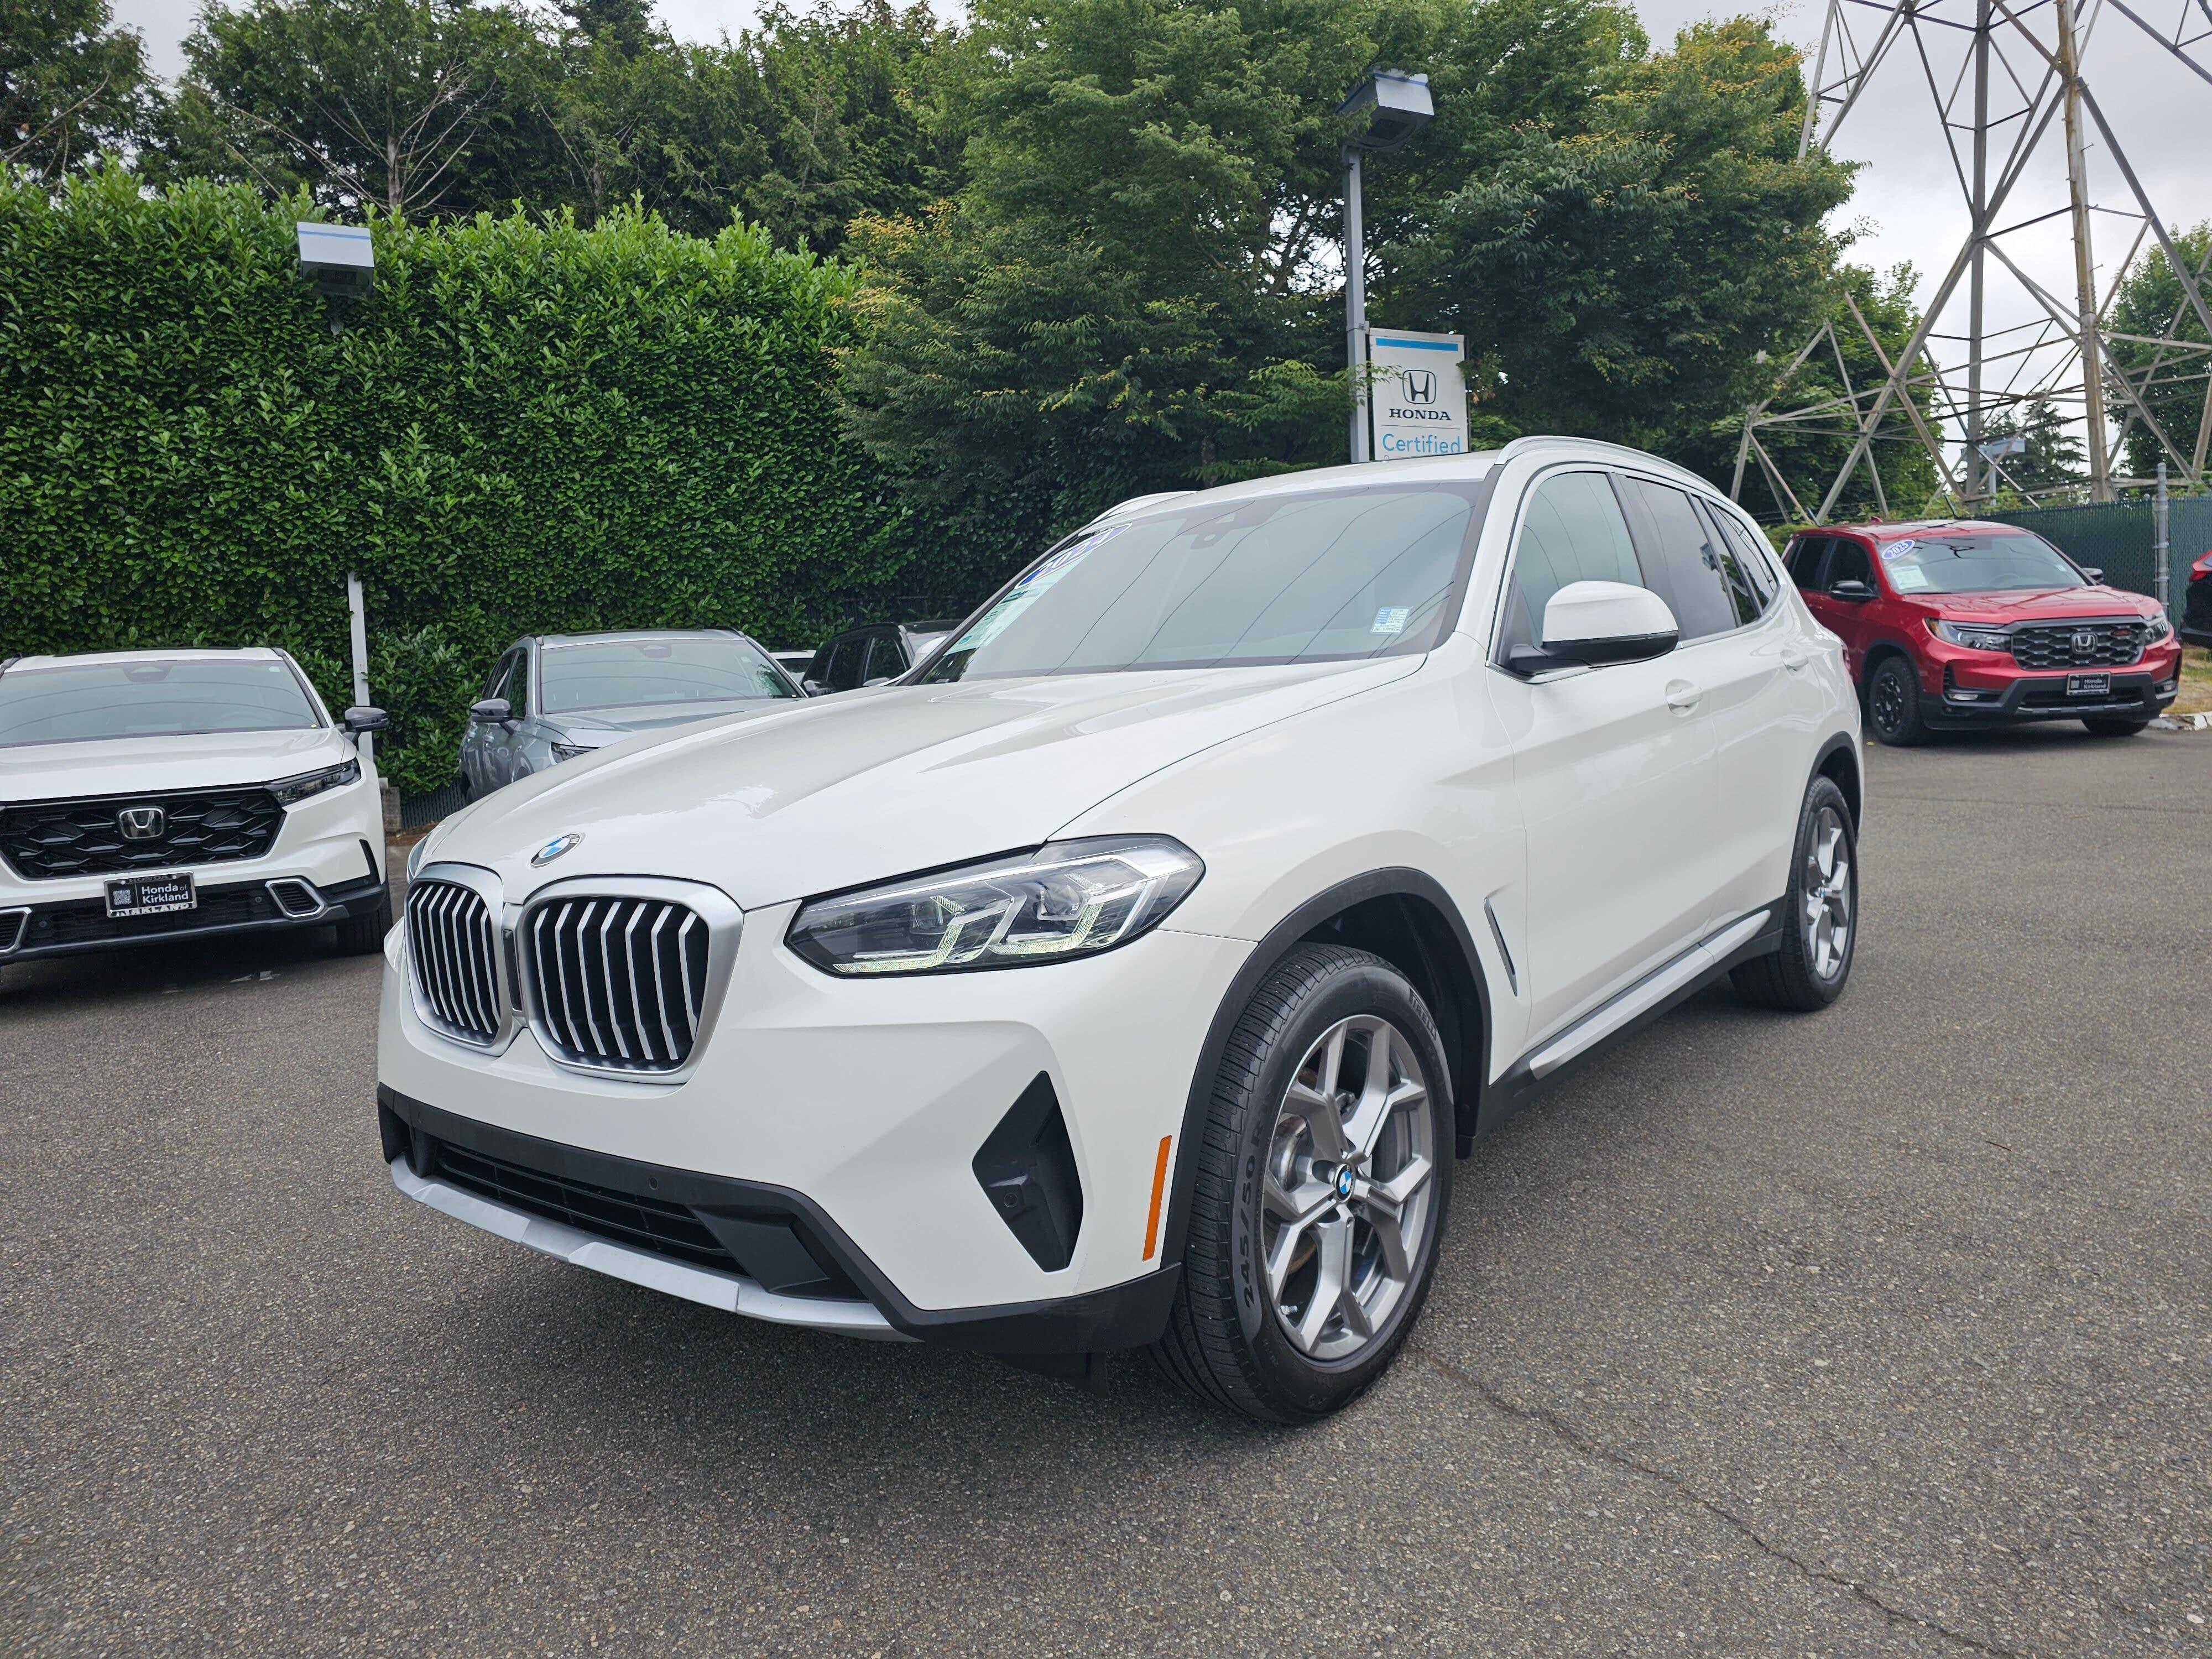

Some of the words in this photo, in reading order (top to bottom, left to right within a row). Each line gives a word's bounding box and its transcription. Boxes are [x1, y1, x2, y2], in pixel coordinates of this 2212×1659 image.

[1389, 408, 1452, 420] HONDA
[1383, 433, 1460, 454] Certified
[1887, 542, 1910, 557] 2025
[128, 875, 170, 884] HONDA
[142, 884, 179, 895] Honda
[143, 891, 189, 904] Kirkland
[1239, 1155, 1255, 1309] 245/50
